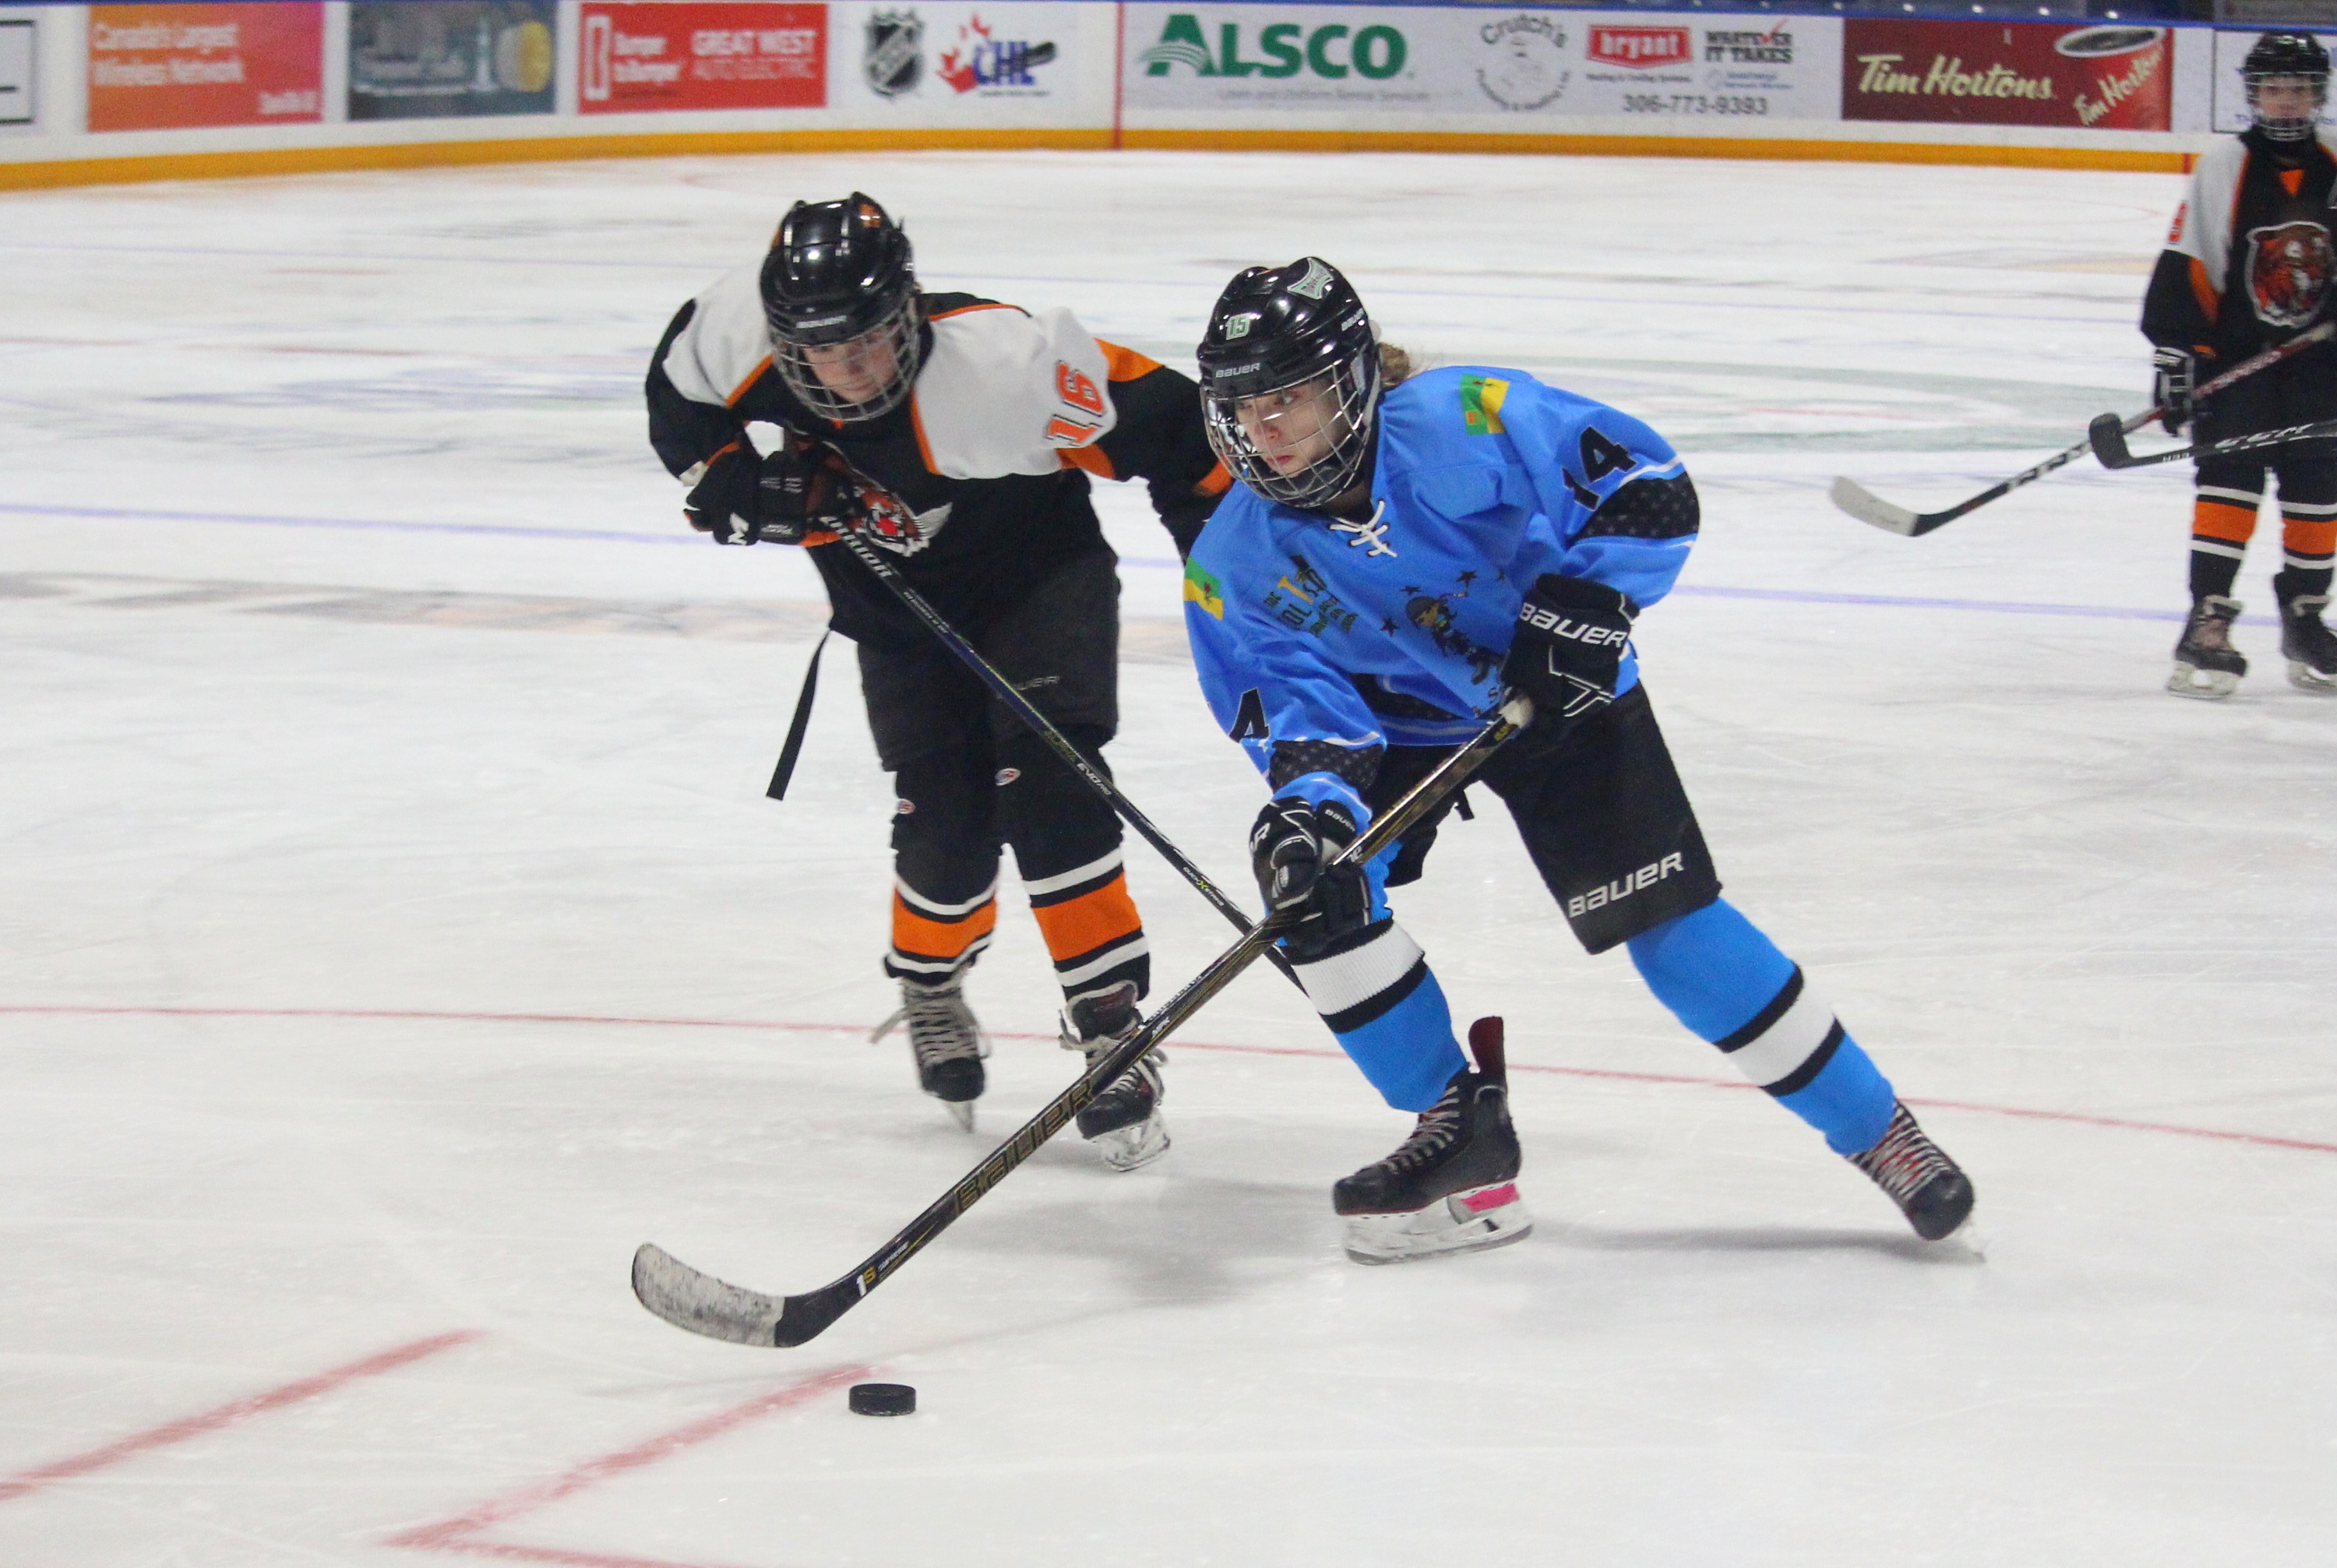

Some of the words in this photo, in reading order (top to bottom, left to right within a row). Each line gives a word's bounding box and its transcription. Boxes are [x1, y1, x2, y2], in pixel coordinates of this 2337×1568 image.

[692, 30, 754, 56] GREAT
[759, 29, 816, 54] WEST
[1144, 13, 1408, 79] ALSCO
[1599, 32, 1679, 59] bryant
[1704, 47, 1725, 62] IT
[1732, 48, 1793, 64] TAKES
[1857, 54, 1919, 94] Tim
[1922, 54, 2052, 100] Hortons
[1623, 94, 1768, 115] 306-773-9393
[2073, 93, 2110, 126] Tim
[1226, 314, 1250, 339] 15
[1215, 362, 1260, 378] BAUER
[1045, 360, 1104, 446] 16
[1560, 425, 1639, 511] 14
[1519, 602, 1629, 648] BAUER
[1567, 851, 1684, 918] BAUER
